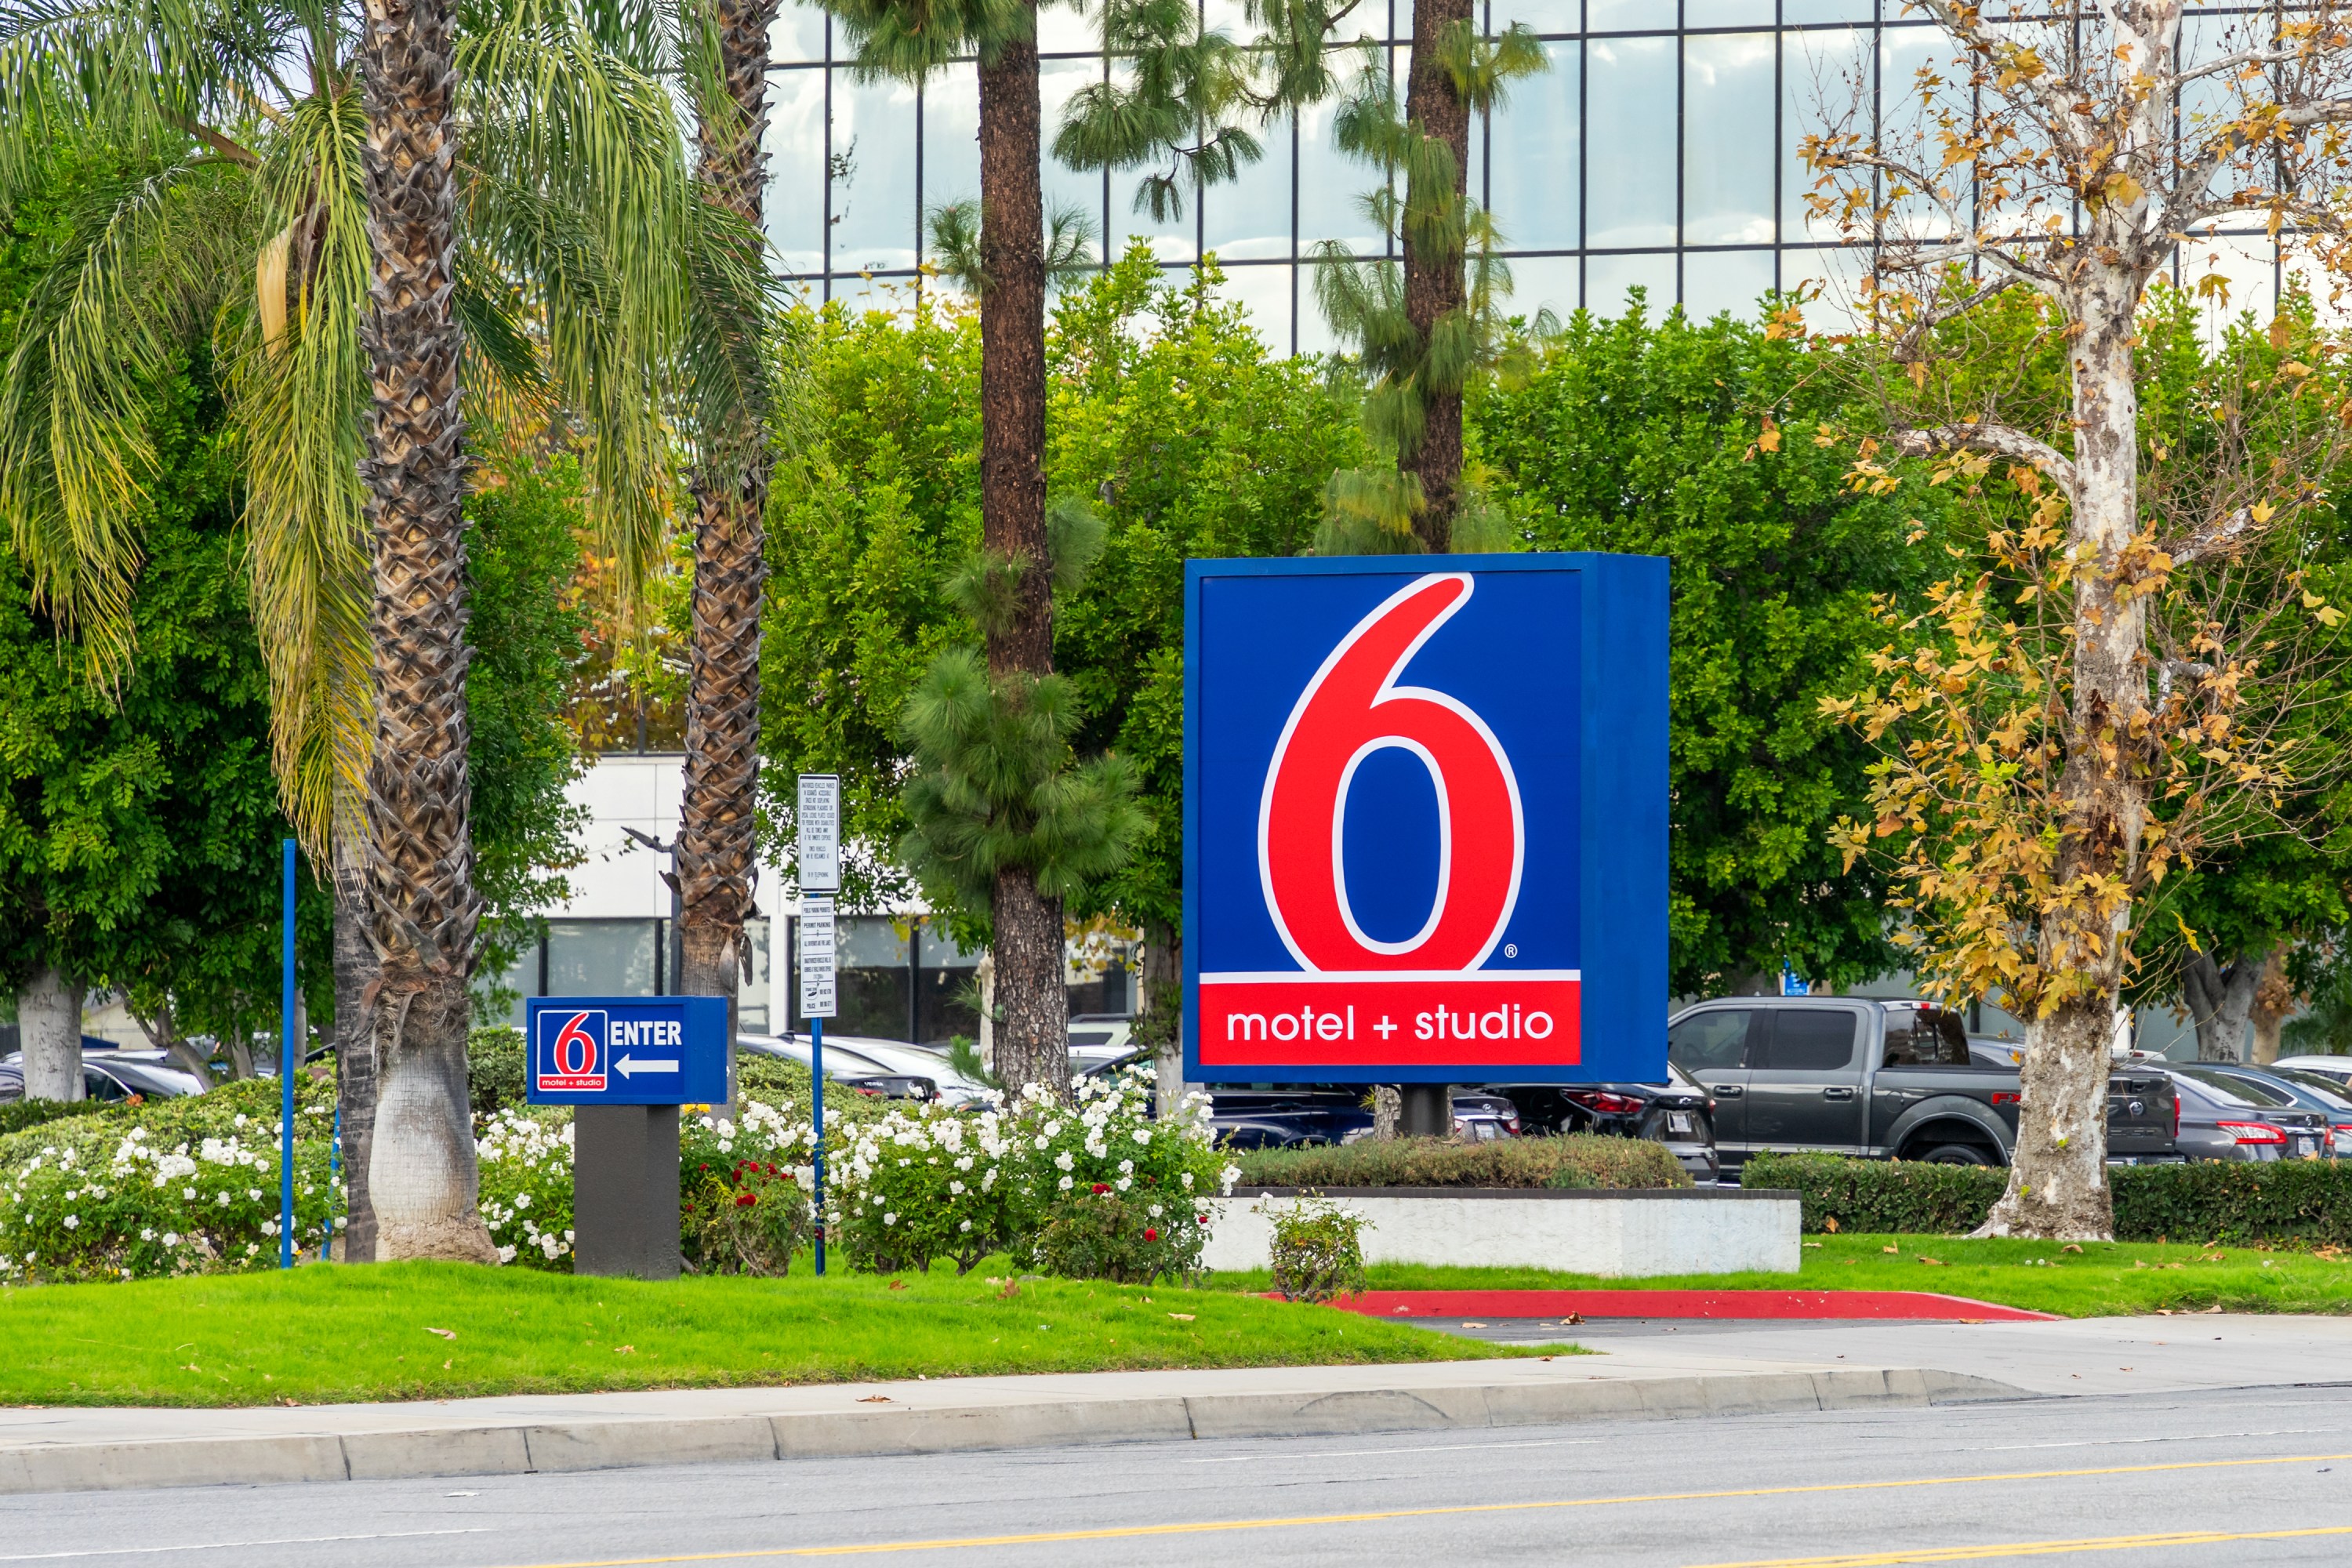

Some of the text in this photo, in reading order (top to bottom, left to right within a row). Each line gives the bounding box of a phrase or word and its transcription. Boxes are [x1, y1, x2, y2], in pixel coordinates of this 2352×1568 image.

[1258, 572, 1525, 973] 6
[554, 1012, 597, 1075] 6
[610, 1021, 682, 1046] ENTER
[1227, 1004, 1554, 1041] motel + studio
